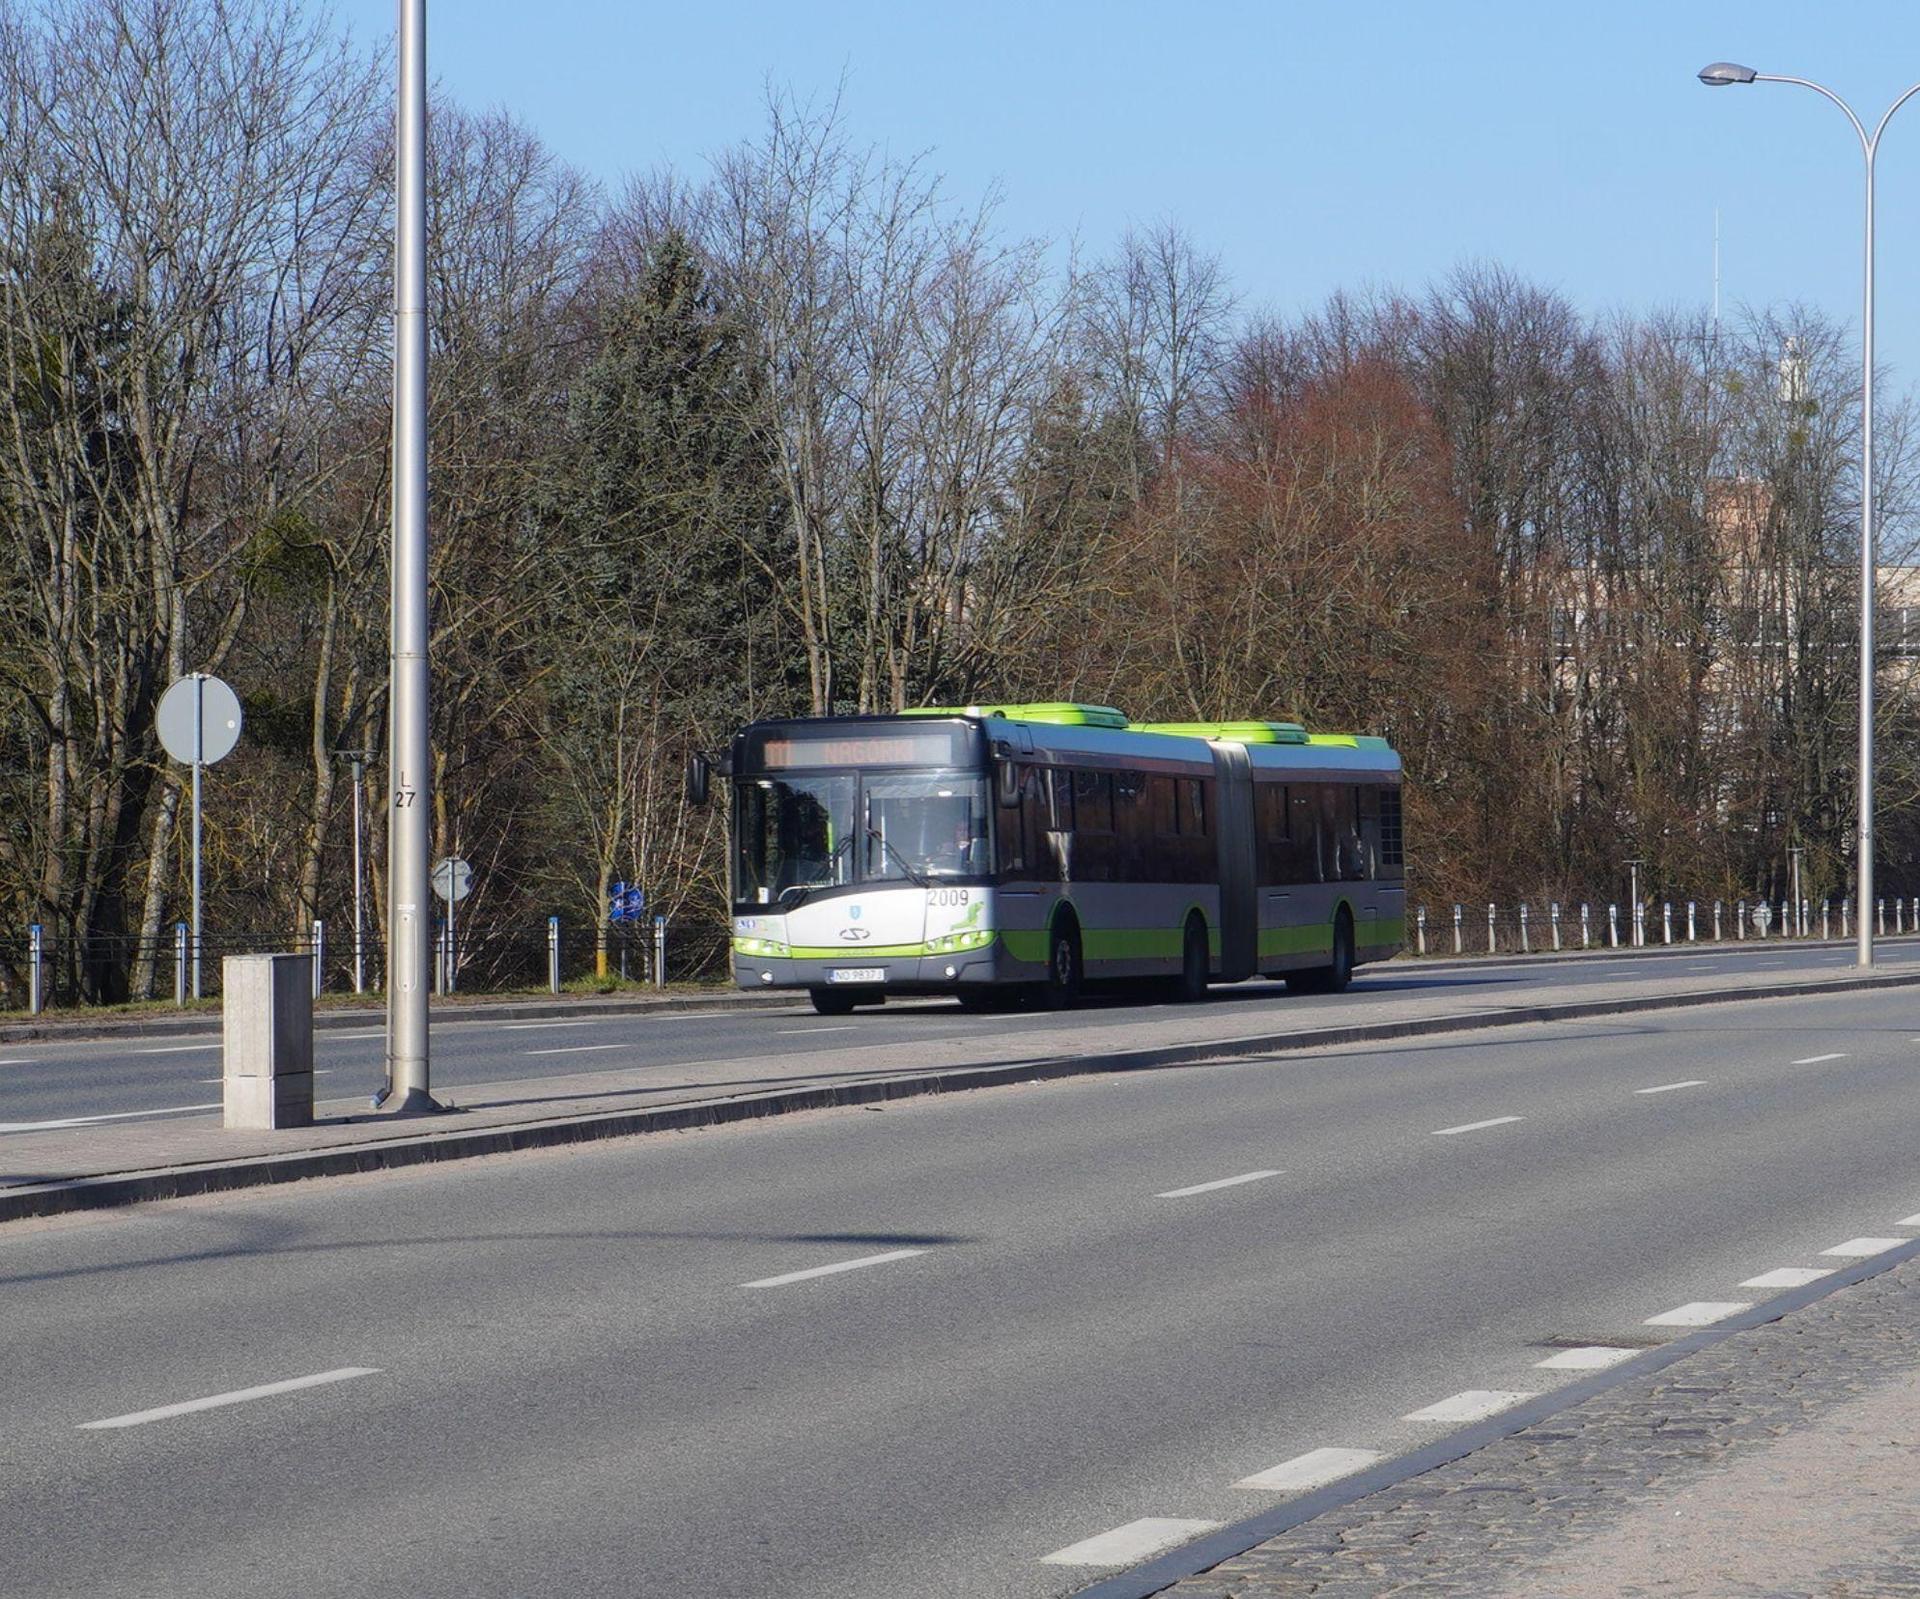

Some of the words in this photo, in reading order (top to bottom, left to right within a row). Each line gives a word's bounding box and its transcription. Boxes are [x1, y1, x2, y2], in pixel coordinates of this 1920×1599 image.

[401, 770, 411, 787] L
[395, 791, 416, 808] 27
[927, 889, 969, 906] 2009
